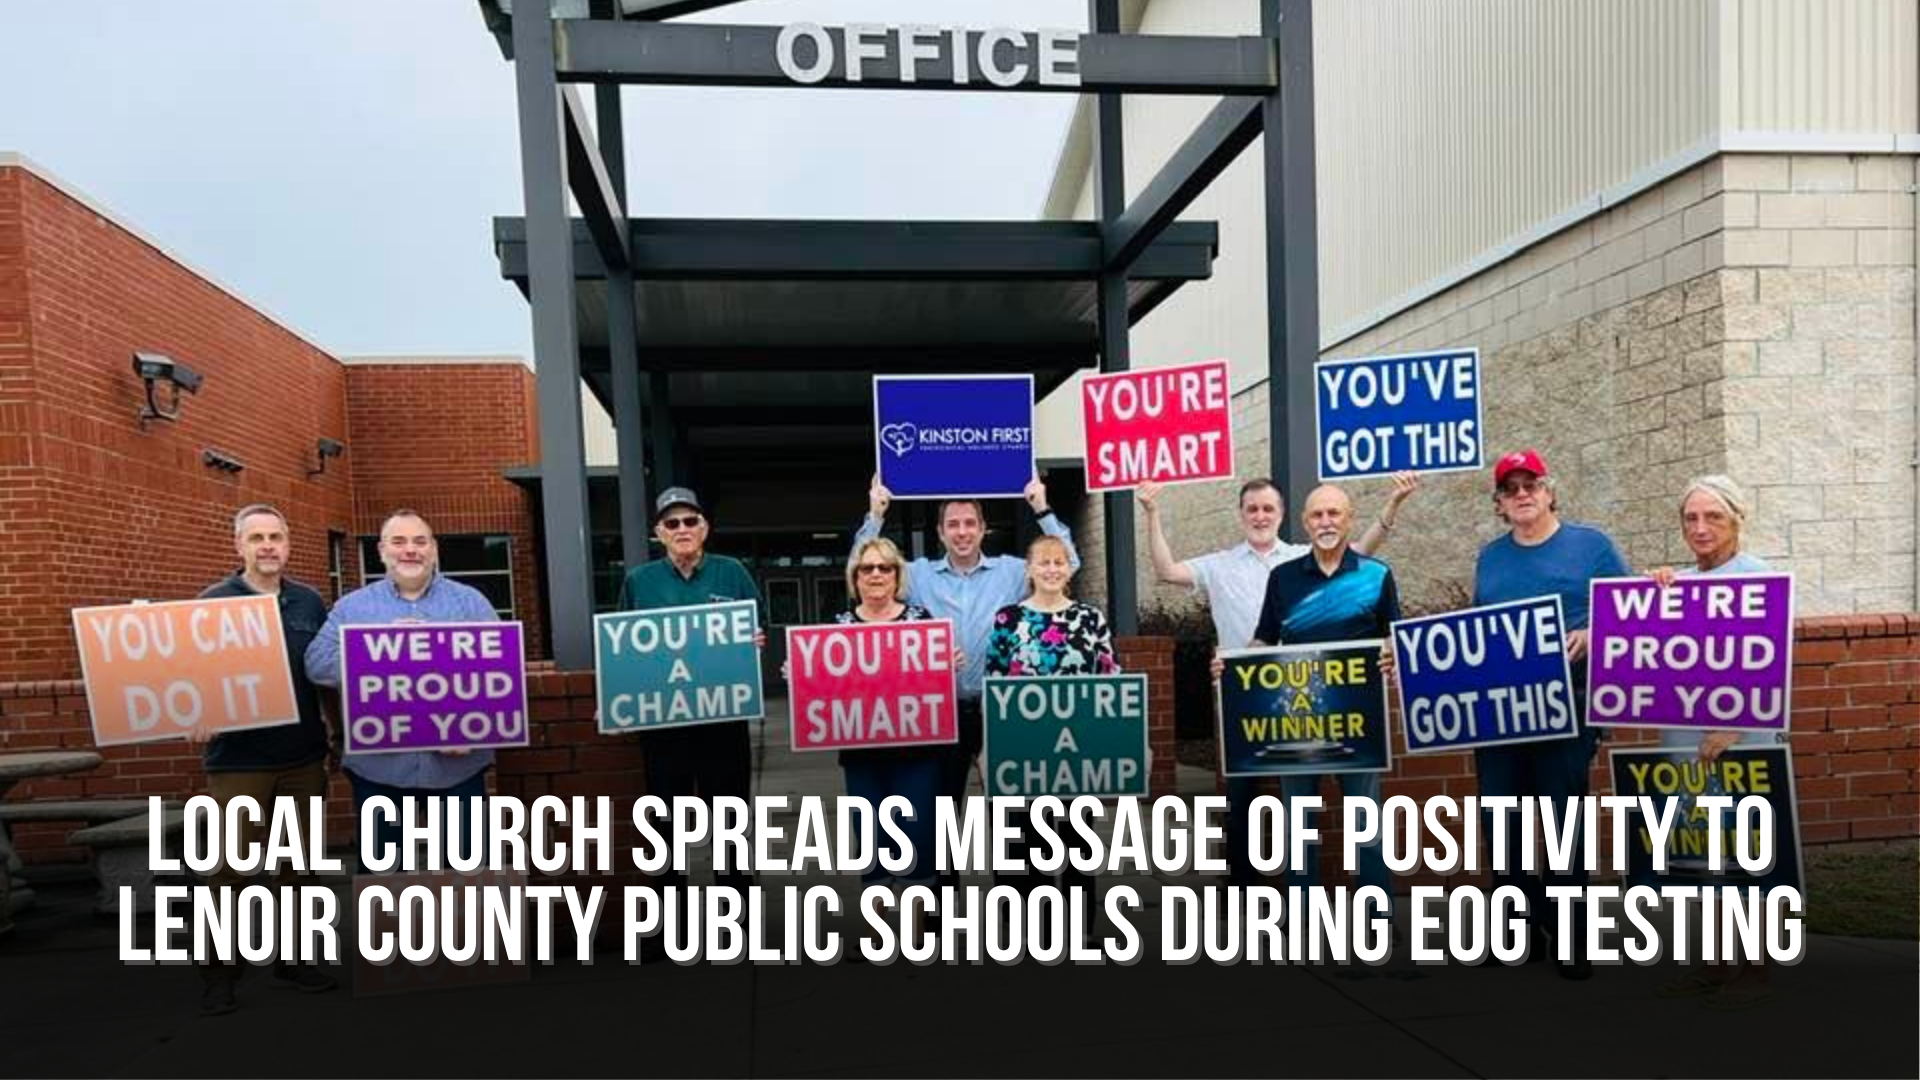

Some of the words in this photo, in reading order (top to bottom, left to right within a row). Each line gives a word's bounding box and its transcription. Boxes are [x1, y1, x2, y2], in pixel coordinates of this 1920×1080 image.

[776, 22, 1081, 87] OFFICE
[1087, 367, 1224, 423] YOU'RE
[1320, 357, 1474, 409] YOU'VE
[919, 428, 988, 443] KINSTON
[992, 427, 1030, 443] FIRST
[1325, 426, 1395, 473] GOT
[1403, 420, 1475, 467] THIS
[1100, 431, 1220, 483] SMART
[1611, 583, 1767, 621] WE'RE
[90, 610, 176, 662] YOU
[190, 604, 271, 655] CAN
[364, 631, 503, 662] WE'RE
[603, 611, 752, 655] YOU'RE
[1399, 606, 1560, 673] YOU'VE
[668, 660, 692, 682] A
[794, 630, 949, 679] YOU'RE
[1603, 635, 1775, 671] PROUD
[359, 672, 513, 703] PROUD
[1235, 657, 1367, 692] YOU'RE
[124, 679, 201, 732] DO
[223, 674, 262, 719] IT
[611, 683, 752, 727] CHAMP
[807, 694, 945, 743] SMART
[991, 681, 1141, 721] YOU'RE
[1290, 692, 1311, 711] A
[1410, 692, 1480, 744] GOT
[1488, 680, 1568, 735] THIS
[1593, 684, 1655, 717] OF
[1675, 686, 1782, 721] YOU
[352, 714, 413, 745] OF
[431, 710, 522, 742] YOU
[1054, 728, 1078, 752] A
[1242, 713, 1365, 743] WINNER
[995, 758, 1138, 795] CHAMP
[1628, 760, 1772, 795] YOU'RE
